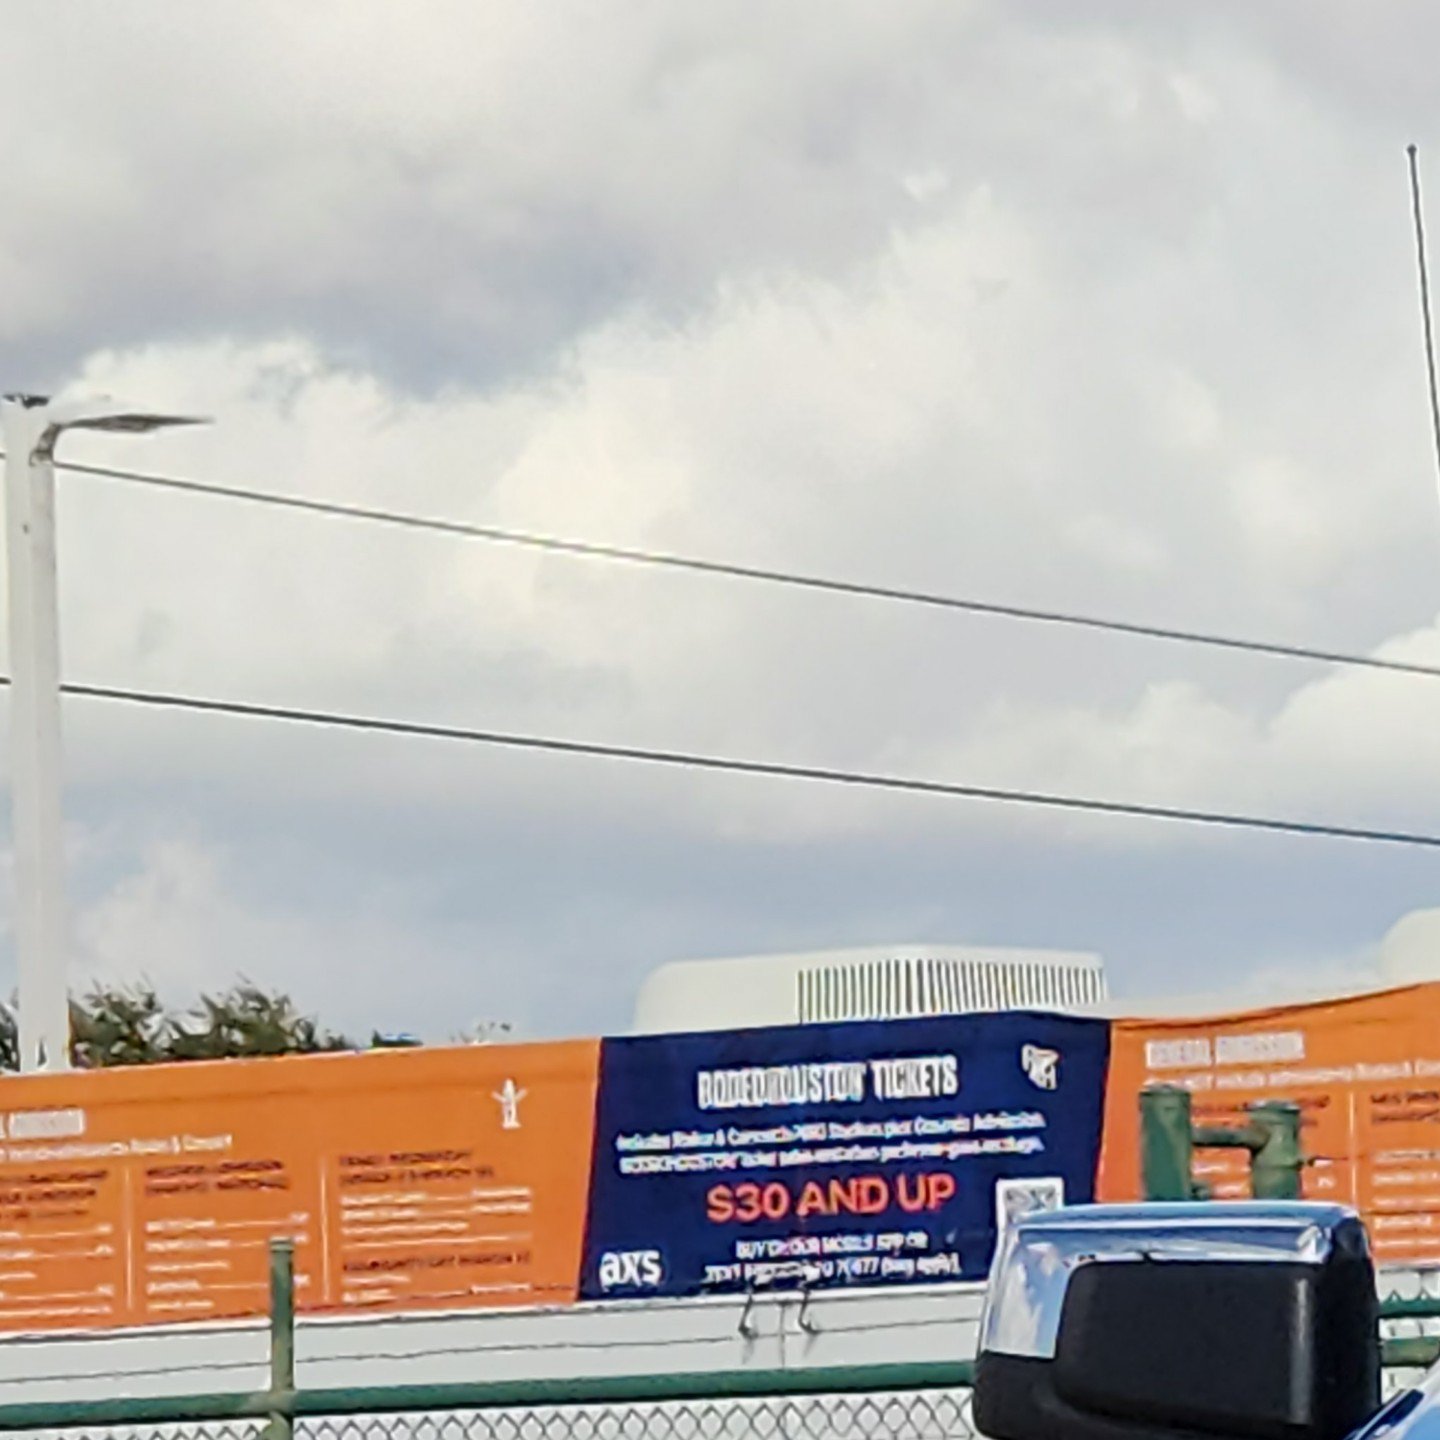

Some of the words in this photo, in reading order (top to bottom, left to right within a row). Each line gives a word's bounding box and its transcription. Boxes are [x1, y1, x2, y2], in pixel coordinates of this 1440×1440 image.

[872, 1054, 958, 1101] TICKETS
[796, 1175, 889, 1216] AND
[897, 1171, 956, 1213] UP
[599, 1250, 662, 1288] axs
